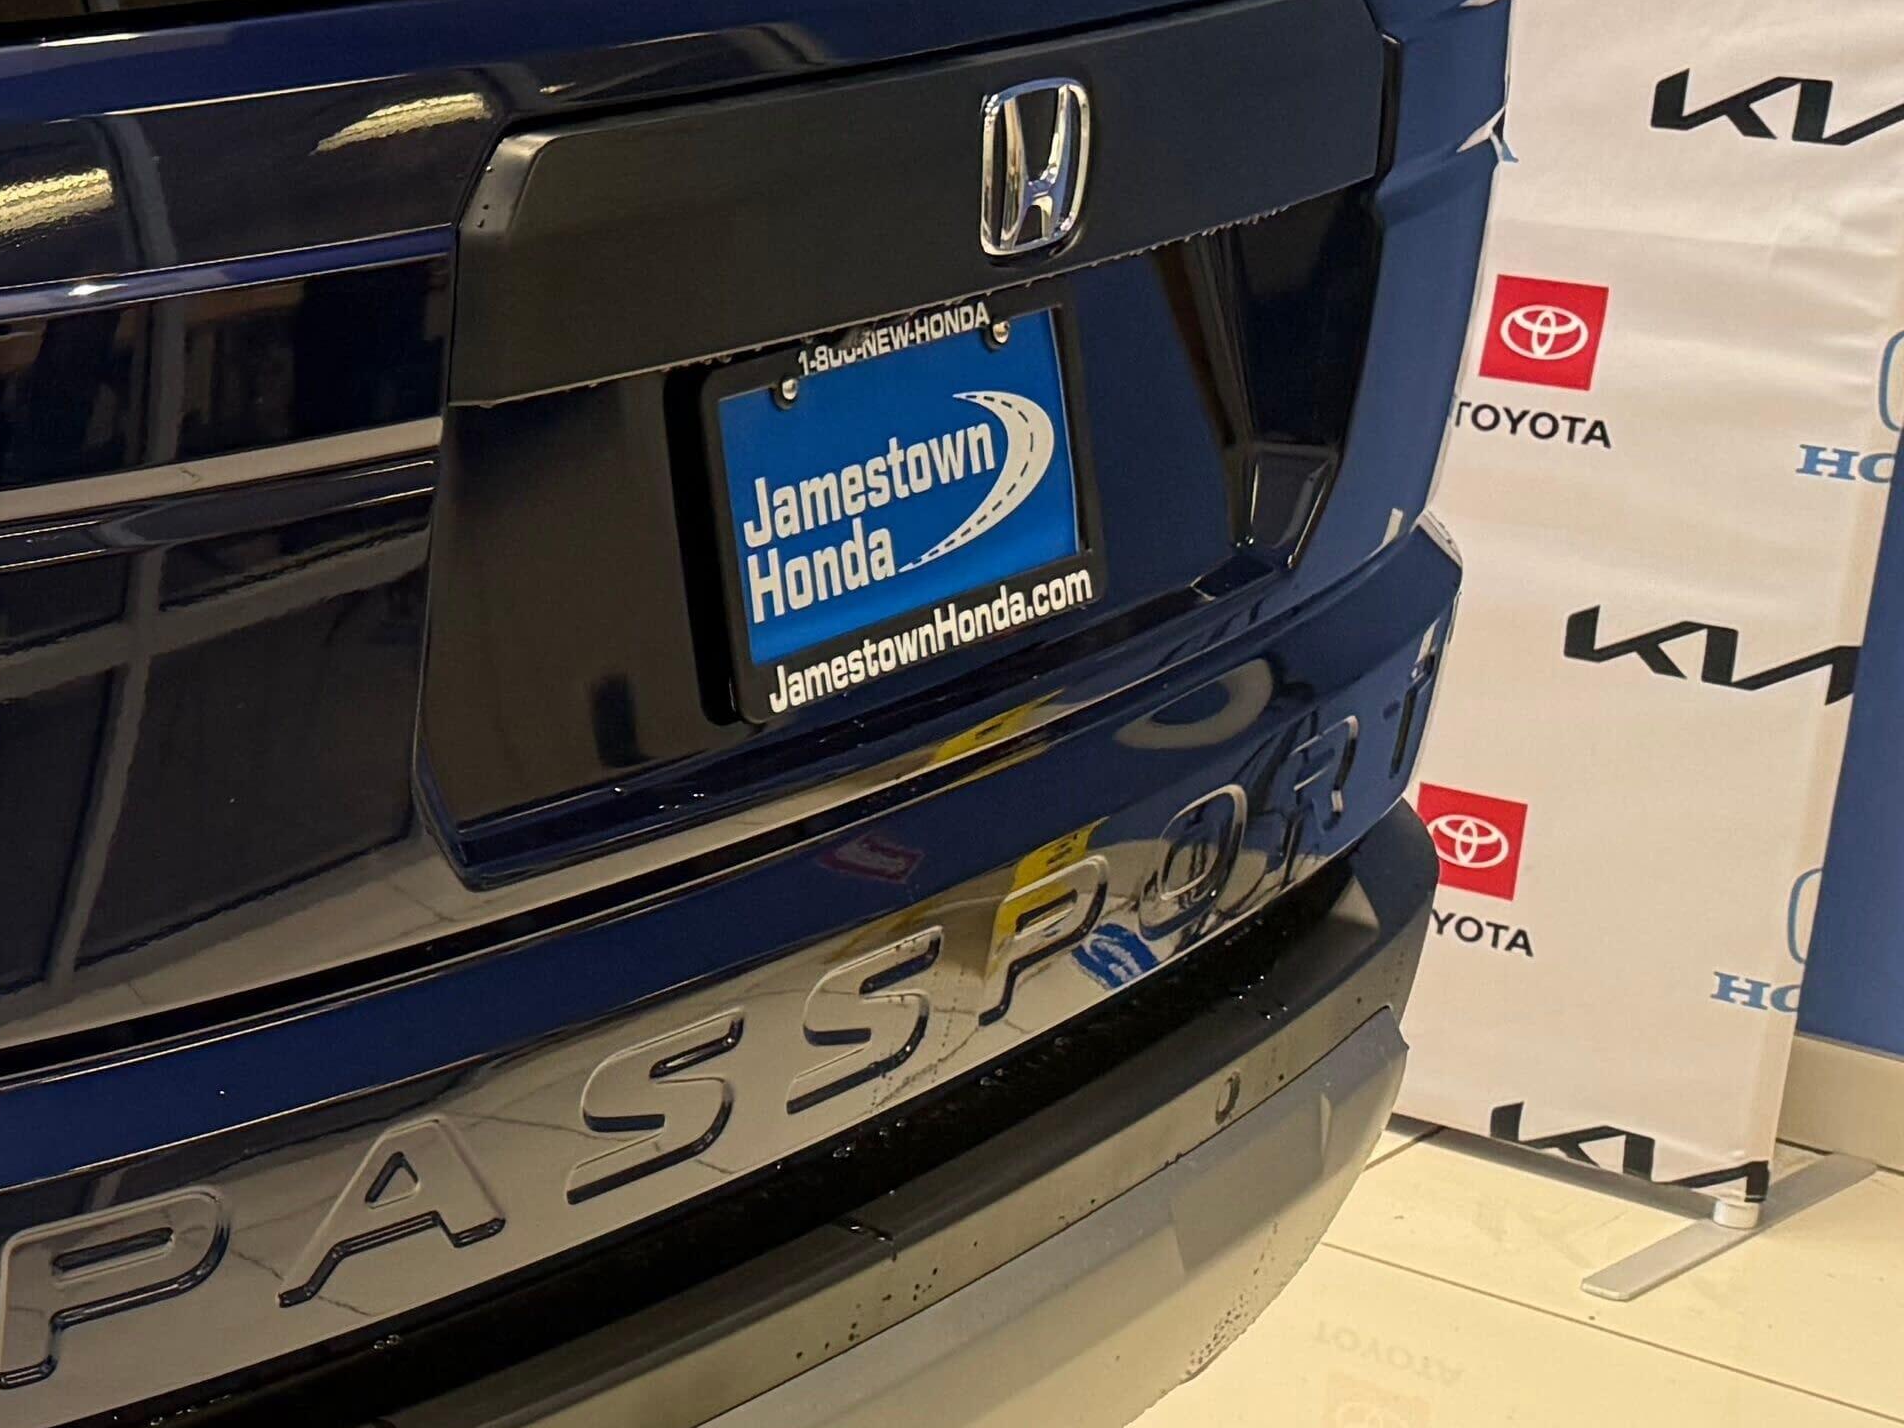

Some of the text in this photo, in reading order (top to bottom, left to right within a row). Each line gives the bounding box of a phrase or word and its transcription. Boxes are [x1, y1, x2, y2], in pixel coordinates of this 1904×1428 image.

[1454, 400, 1612, 450] TOYOTA
[742, 421, 996, 549] Jamestown
[746, 517, 896, 625] Honda
[768, 567, 1094, 714] JamestownHonda.com
[1563, 604, 1863, 706] KIA
[1430, 907, 1534, 959] YOTA
